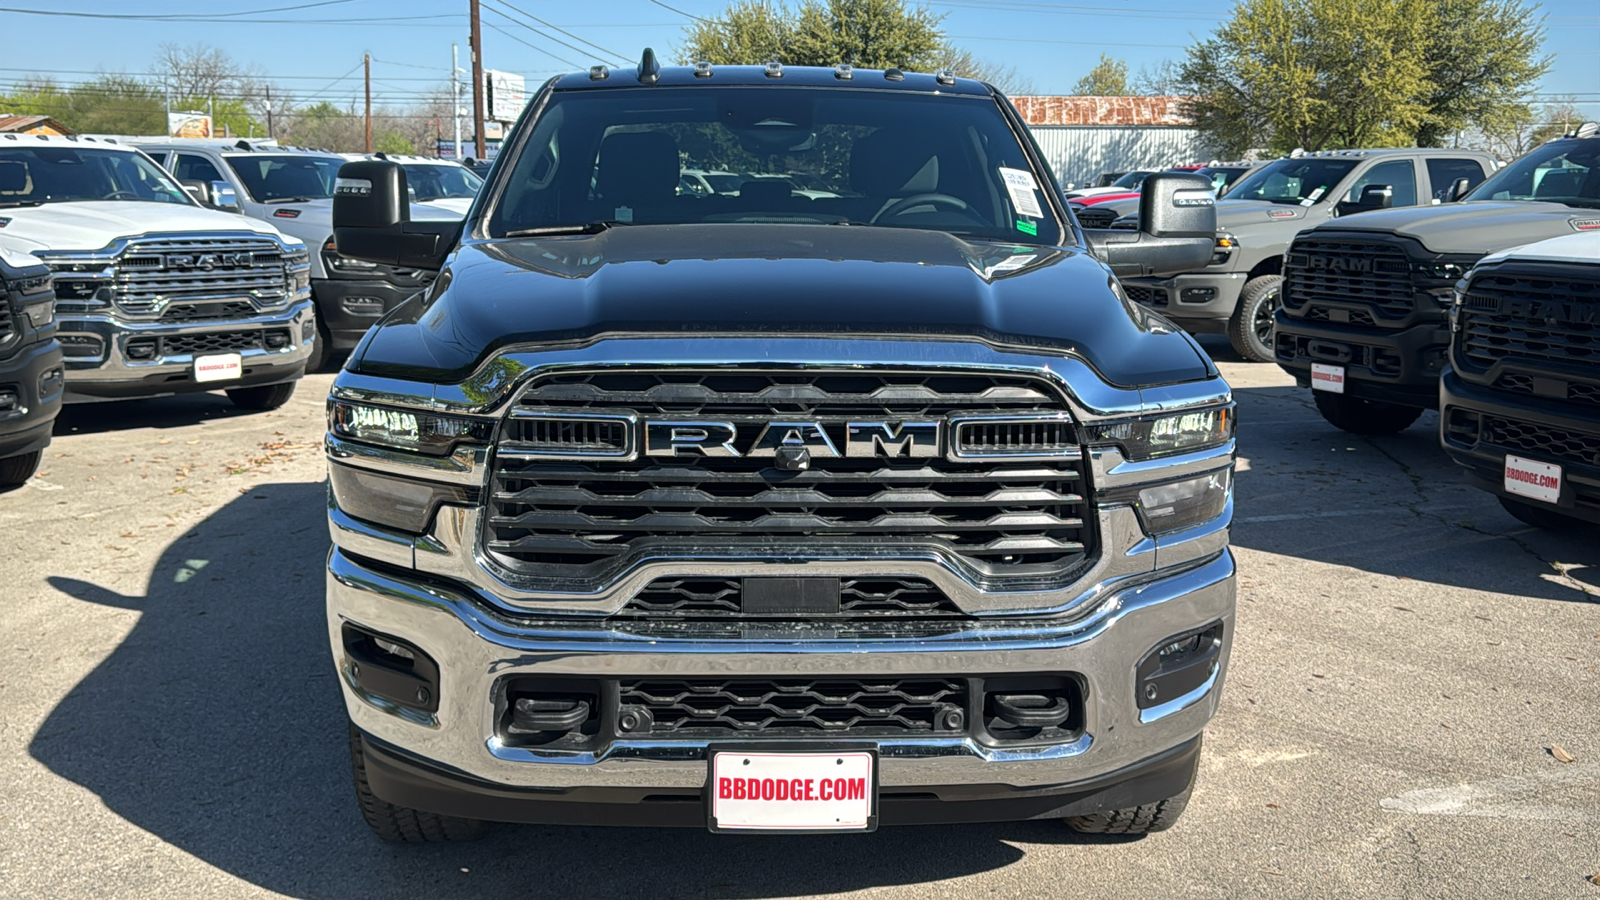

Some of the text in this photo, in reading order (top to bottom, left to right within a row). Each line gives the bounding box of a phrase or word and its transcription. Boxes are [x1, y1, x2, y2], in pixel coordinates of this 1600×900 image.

[166, 253, 252, 268] RAM
[1310, 255, 1372, 272] RAM
[645, 421, 941, 458] RAM
[1506, 467, 1558, 489] BBDODGE.COM
[719, 777, 865, 801] BBDODGE.COM
